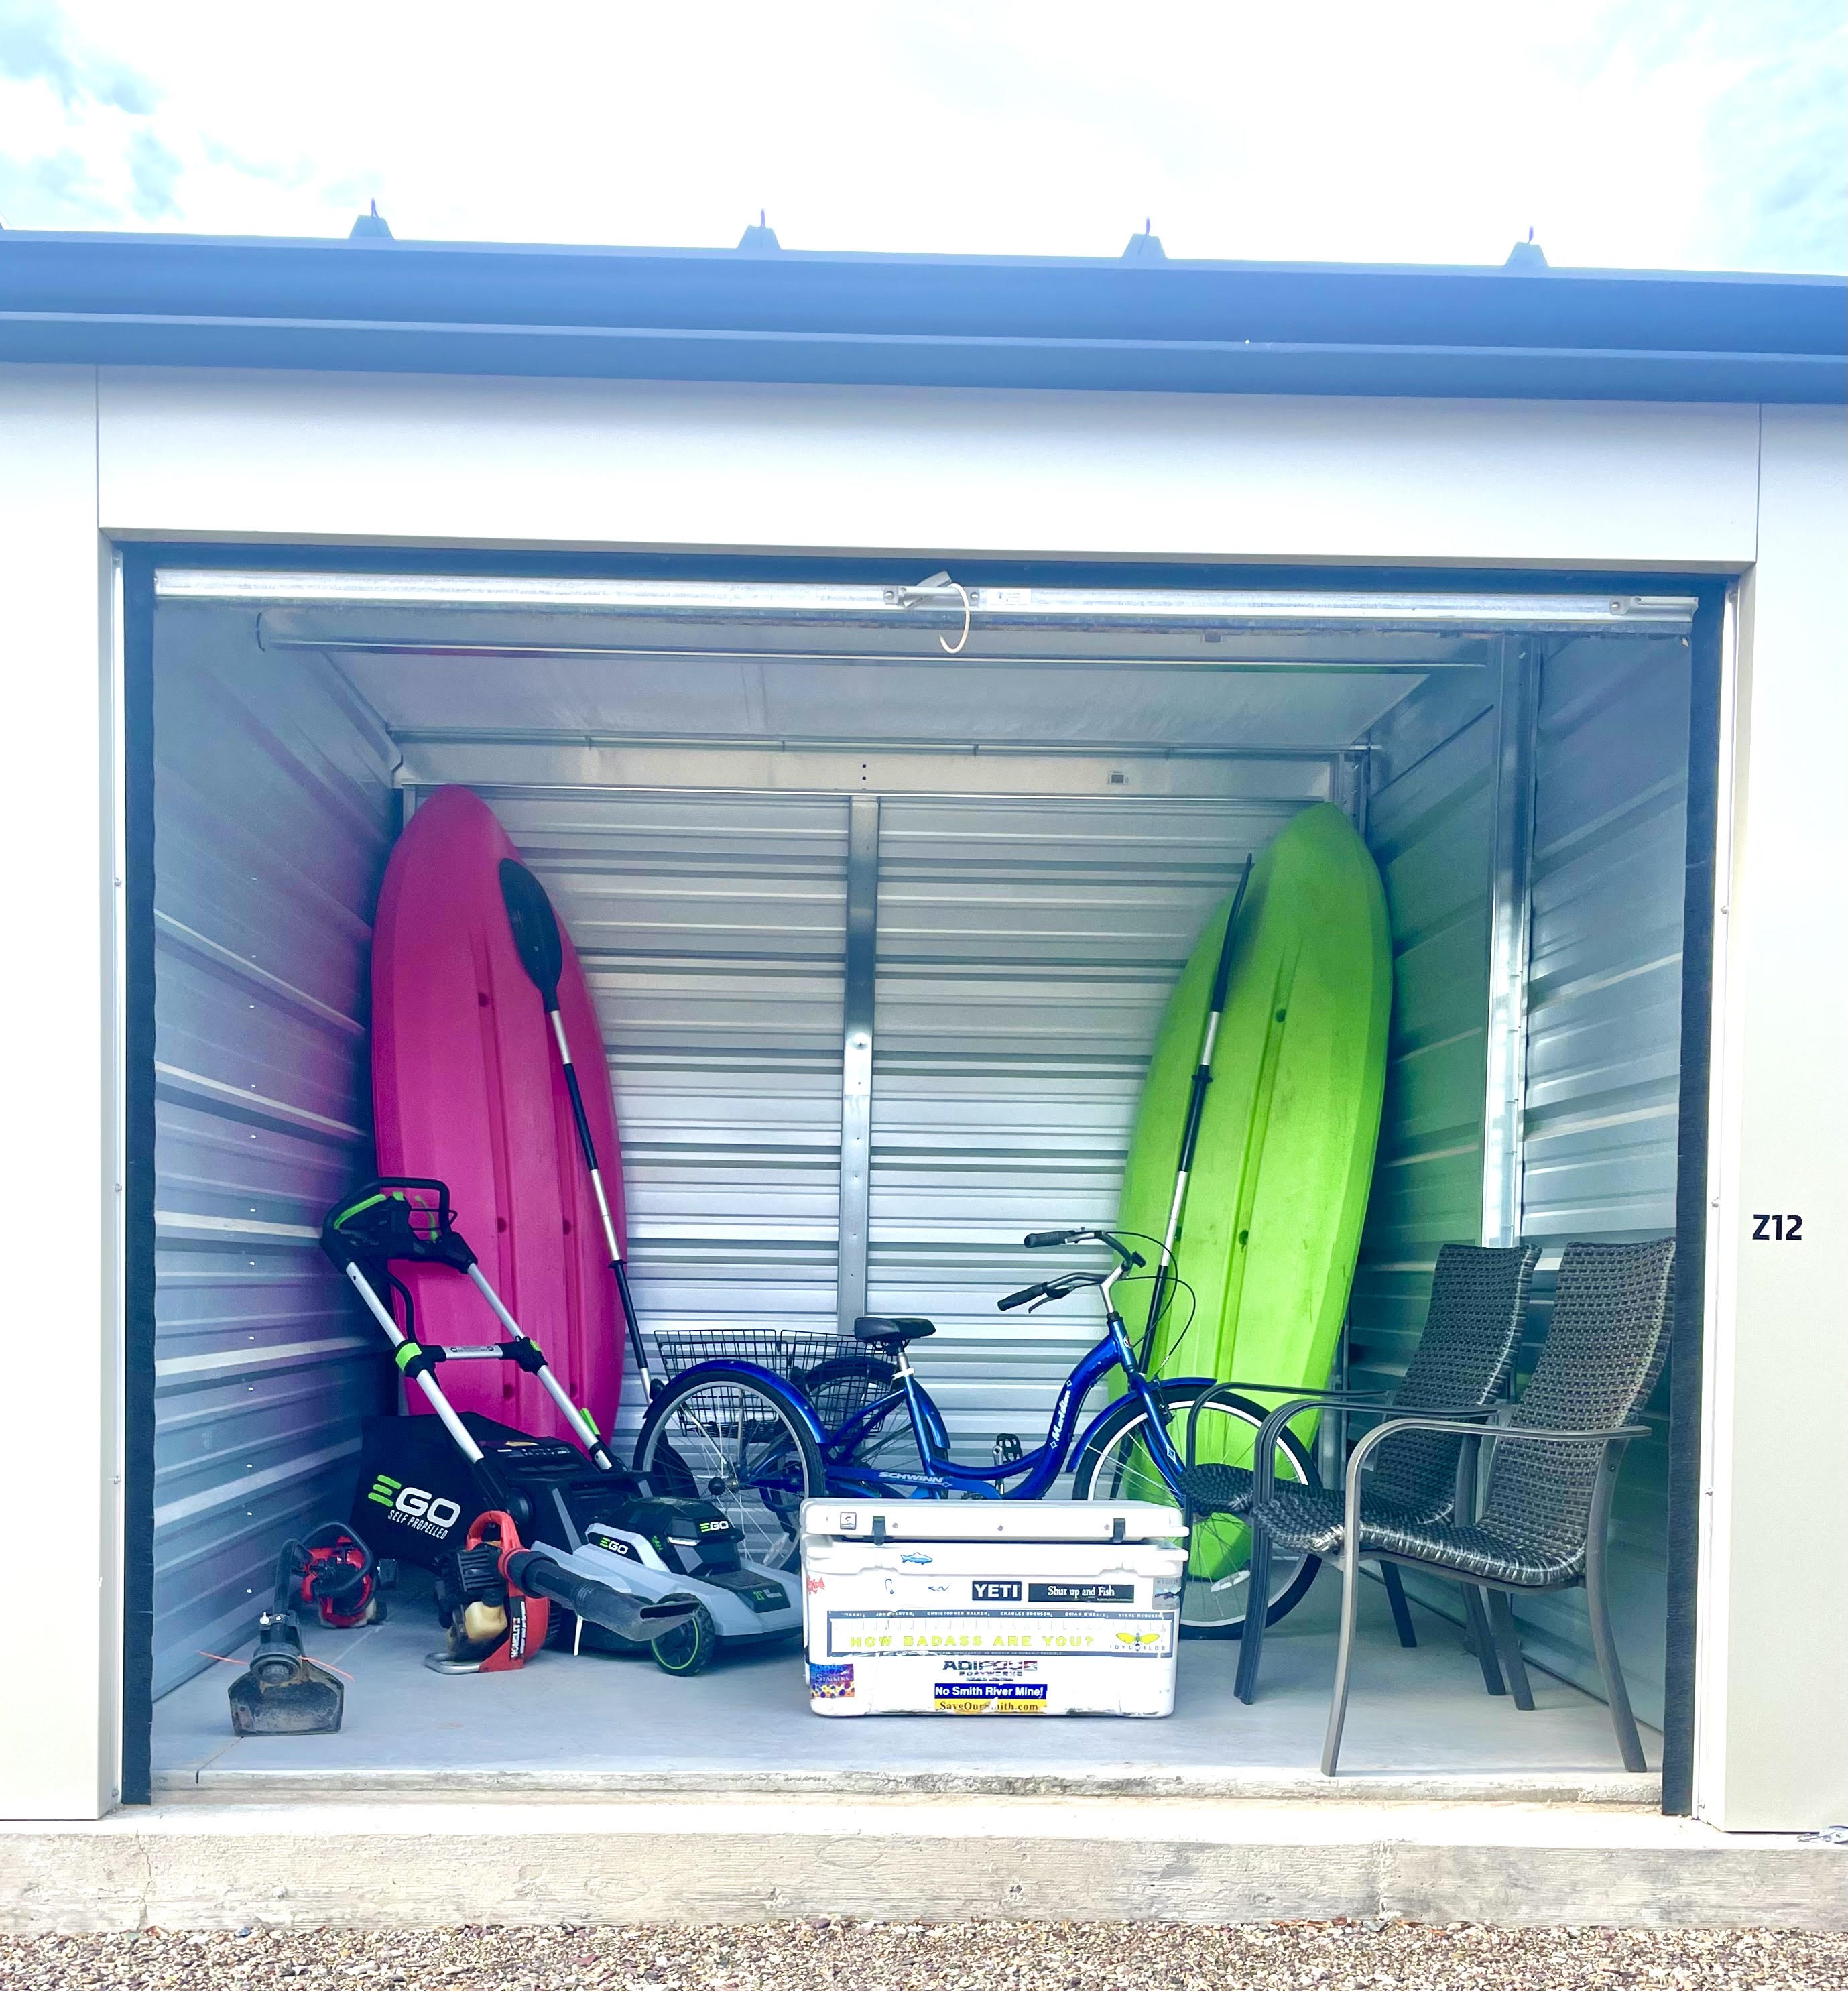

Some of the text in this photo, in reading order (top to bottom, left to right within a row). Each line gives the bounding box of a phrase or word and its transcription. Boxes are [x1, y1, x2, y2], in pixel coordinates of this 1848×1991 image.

[1752, 1214, 1802, 1241] Z12
[878, 1471, 944, 1483] SCHWINN
[368, 1475, 461, 1528] EGO
[387, 1510, 448, 1540] SELF PROPELLED
[700, 1520, 729, 1532] EGO
[599, 1536, 629, 1555] EGO
[973, 1584, 1019, 1598] YETI
[1048, 1585, 1115, 1599] Shut up and Fish
[850, 1636, 1094, 1647] HOW BADASS ARE YOU?
[935, 1686, 1044, 1697] No Smith River Mine!
